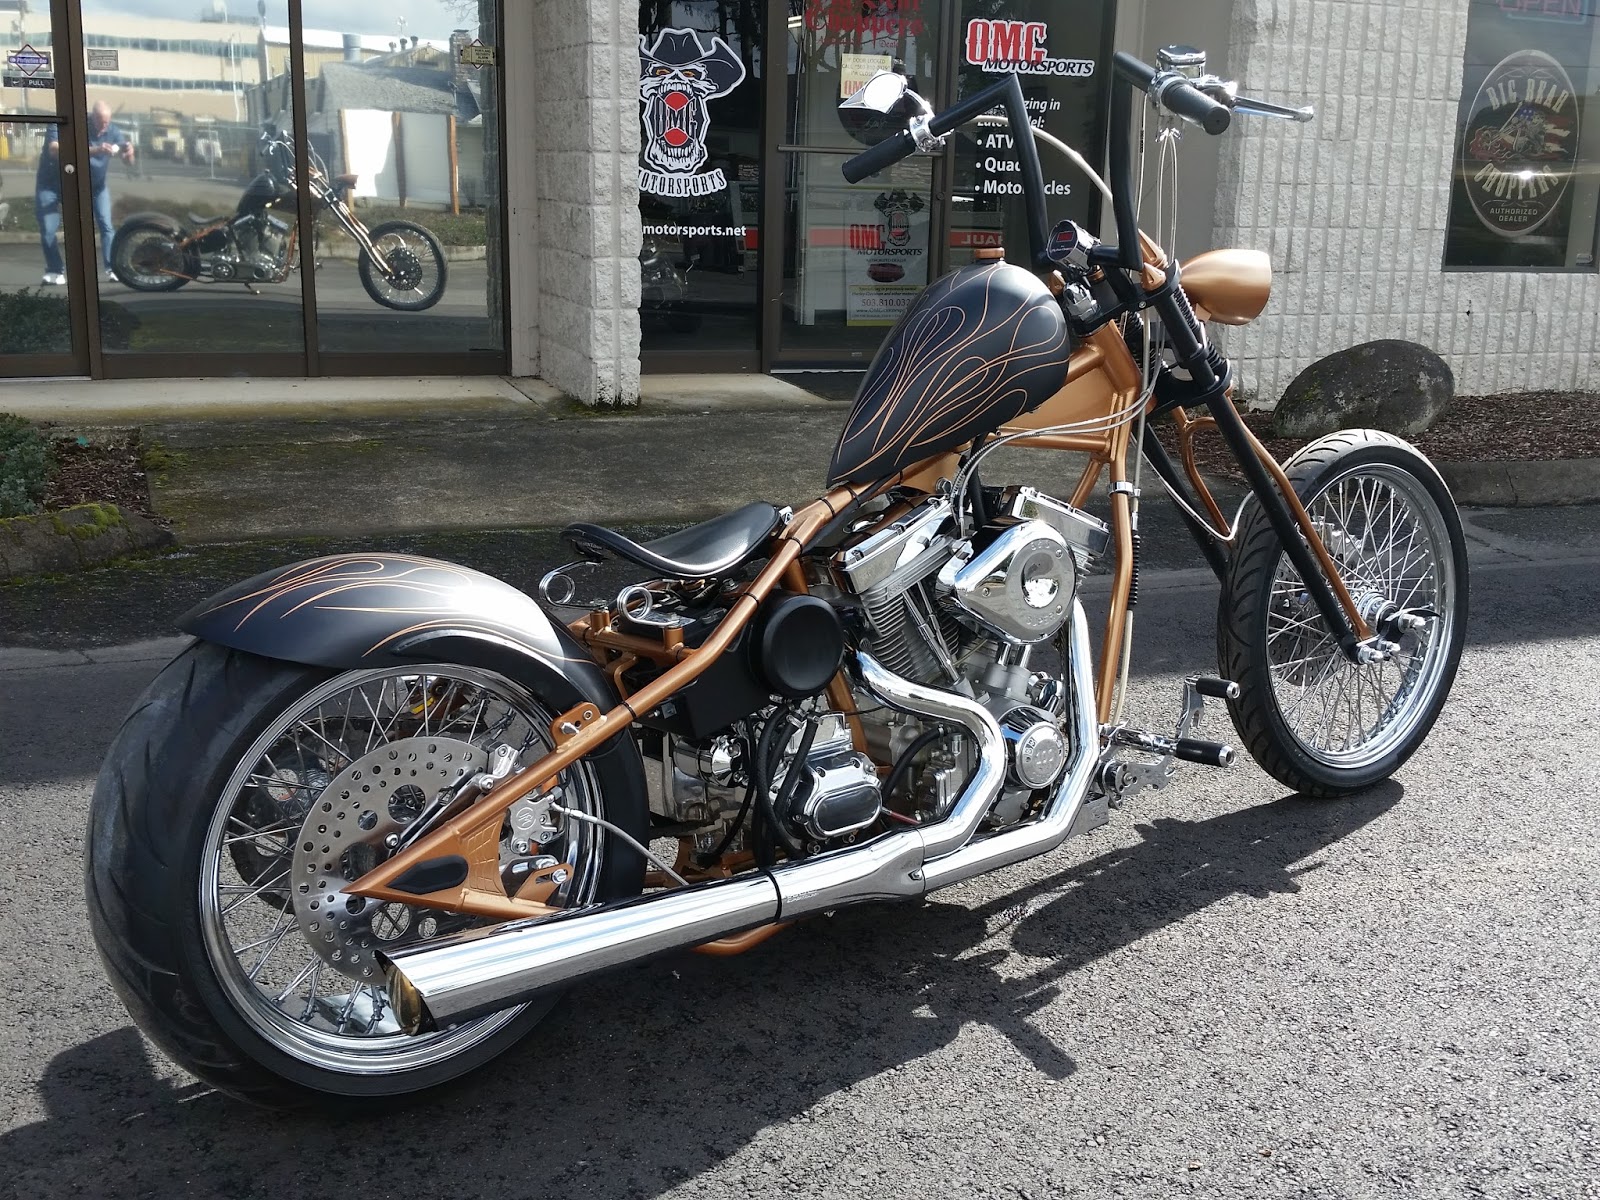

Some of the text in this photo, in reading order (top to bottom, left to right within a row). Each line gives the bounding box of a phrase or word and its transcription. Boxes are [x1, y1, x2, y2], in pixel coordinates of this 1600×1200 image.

[967, 20, 1046, 64] OMG
[983, 58, 1093, 74] MOTORSPORTS
[1049, 98, 1061, 111] in
[1485, 79, 1517, 111] BIG
[639, 168, 725, 195] OTORSPORTS
[1489, 207, 1538, 215] AUTHORIZED
[849, 224, 887, 250] OMG
[857, 248, 923, 256] MOTORSPORTS
